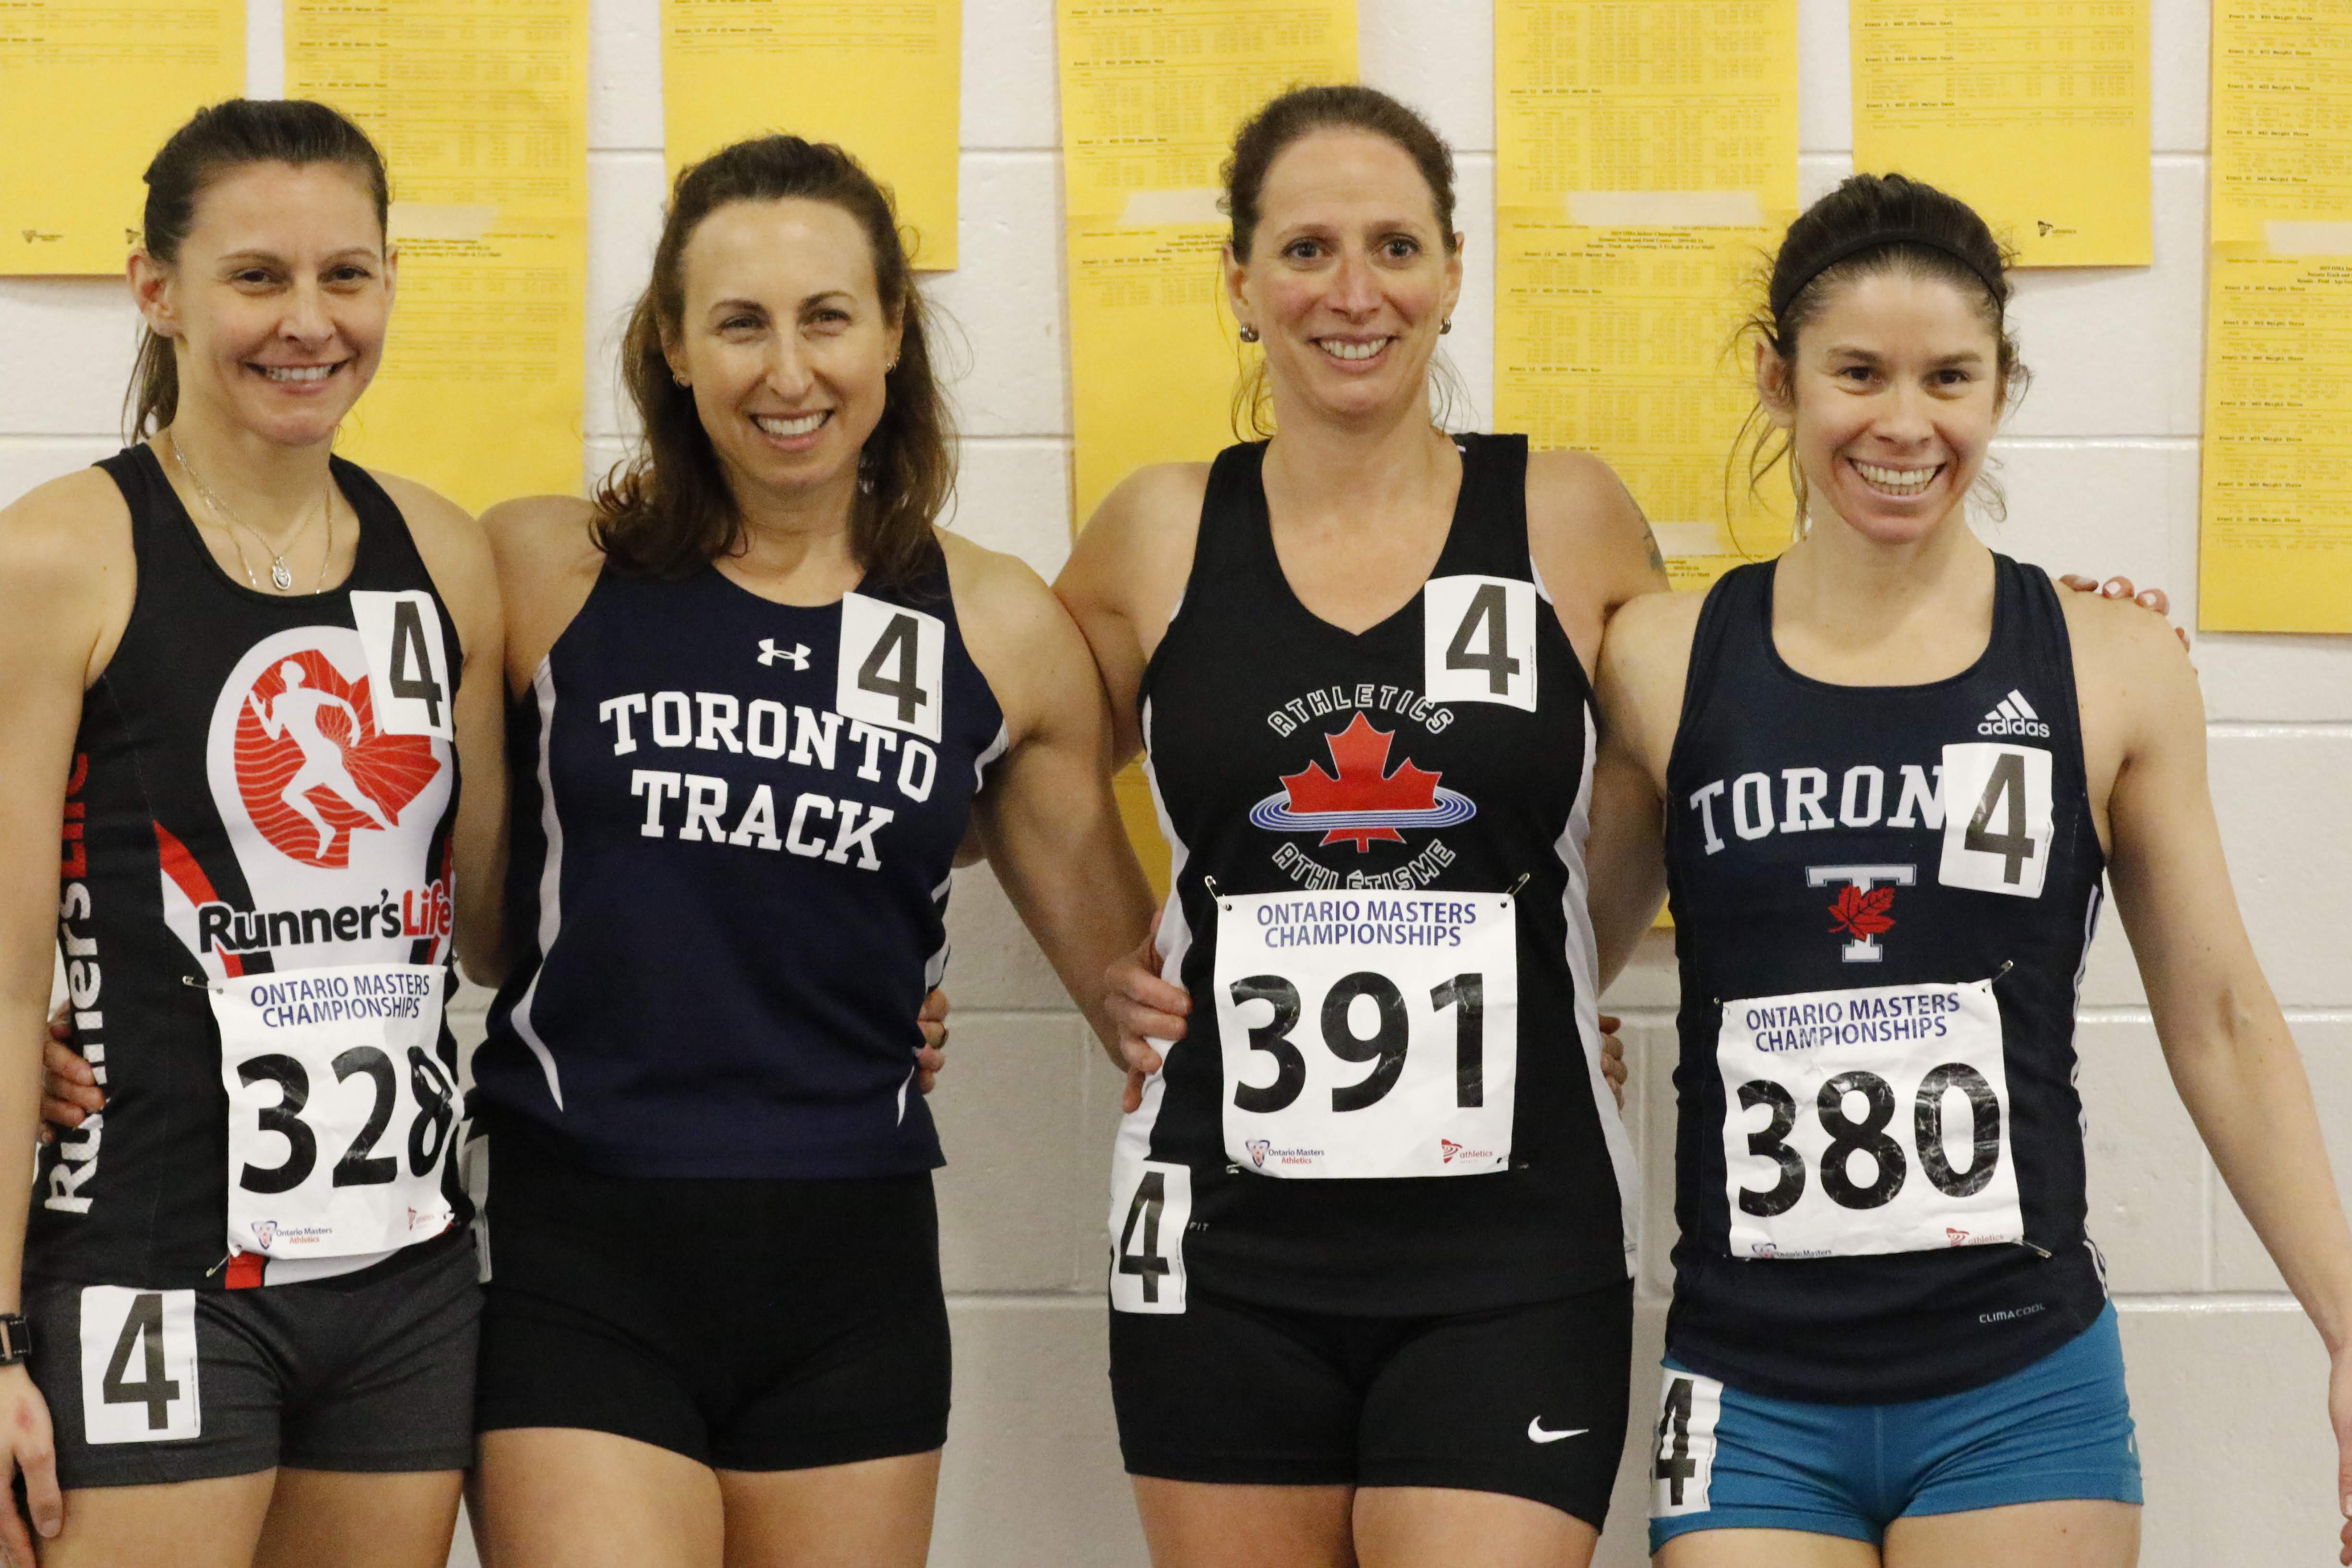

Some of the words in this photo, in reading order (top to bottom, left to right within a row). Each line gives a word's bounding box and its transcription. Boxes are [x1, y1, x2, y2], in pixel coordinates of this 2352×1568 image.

[389, 601, 443, 728] 4
[858, 612, 927, 725] 4
[1446, 583, 1520, 696] 4
[600, 691, 937, 803] TORONTO
[1268, 684, 1454, 737] ATHLETICS
[1977, 718, 2049, 738] adidas
[631, 769, 894, 871] TRACK
[1964, 753, 2035, 884] 4
[1257, 901, 1360, 926] ONTARIO
[1368, 901, 1476, 924] MASTERS
[1265, 924, 1461, 948] CHAMPIONSHIPS
[251, 977, 348, 1007] ONTARIO
[353, 974, 430, 996] MASTERS
[262, 997, 420, 1028] CHAMPIONSHIPS
[1746, 1002, 1842, 1031] ONTARIO
[1849, 993, 1960, 1021] MASTERS
[1229, 971, 1483, 1113] 391
[1756, 1015, 1947, 1053] CHAMPIONSHIPS
[236, 1046, 453, 1194] 328
[1268, 1148, 1295, 1156] Ontario
[1460, 1150, 1492, 1158] athletics
[1736, 1062, 2000, 1217] 380
[276, 1228, 303, 1237] Ontario
[304, 1227, 332, 1235] Masters
[289, 1236, 320, 1244] Athletics
[1119, 1170, 1170, 1303] 4
[103, 1293, 180, 1430] 4
[1655, 1378, 1696, 1507] 4
